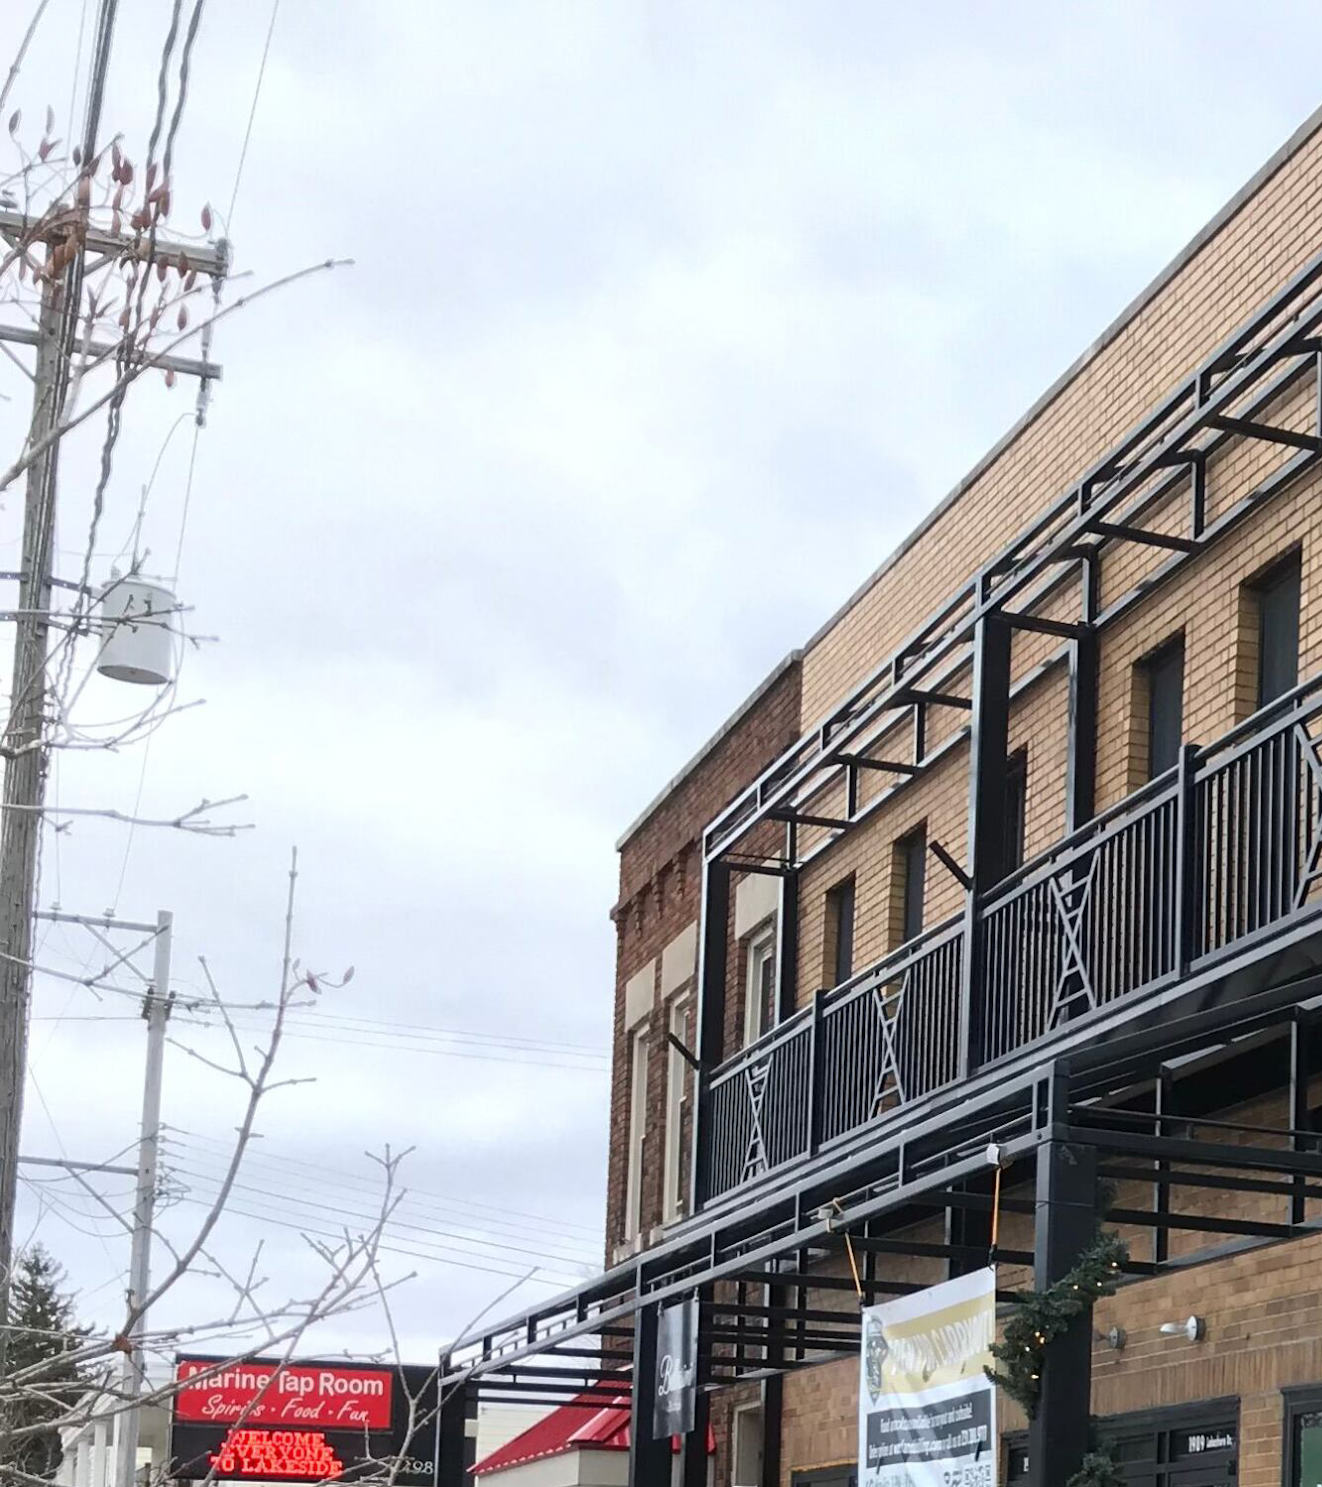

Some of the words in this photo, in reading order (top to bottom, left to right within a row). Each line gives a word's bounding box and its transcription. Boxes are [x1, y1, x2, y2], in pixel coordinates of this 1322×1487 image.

[319, 1372, 384, 1396] Room
[281, 1397, 325, 1419] Food
[230, 1430, 325, 1447] WELCOME
[242, 1458, 342, 1476] LAKESIDE
